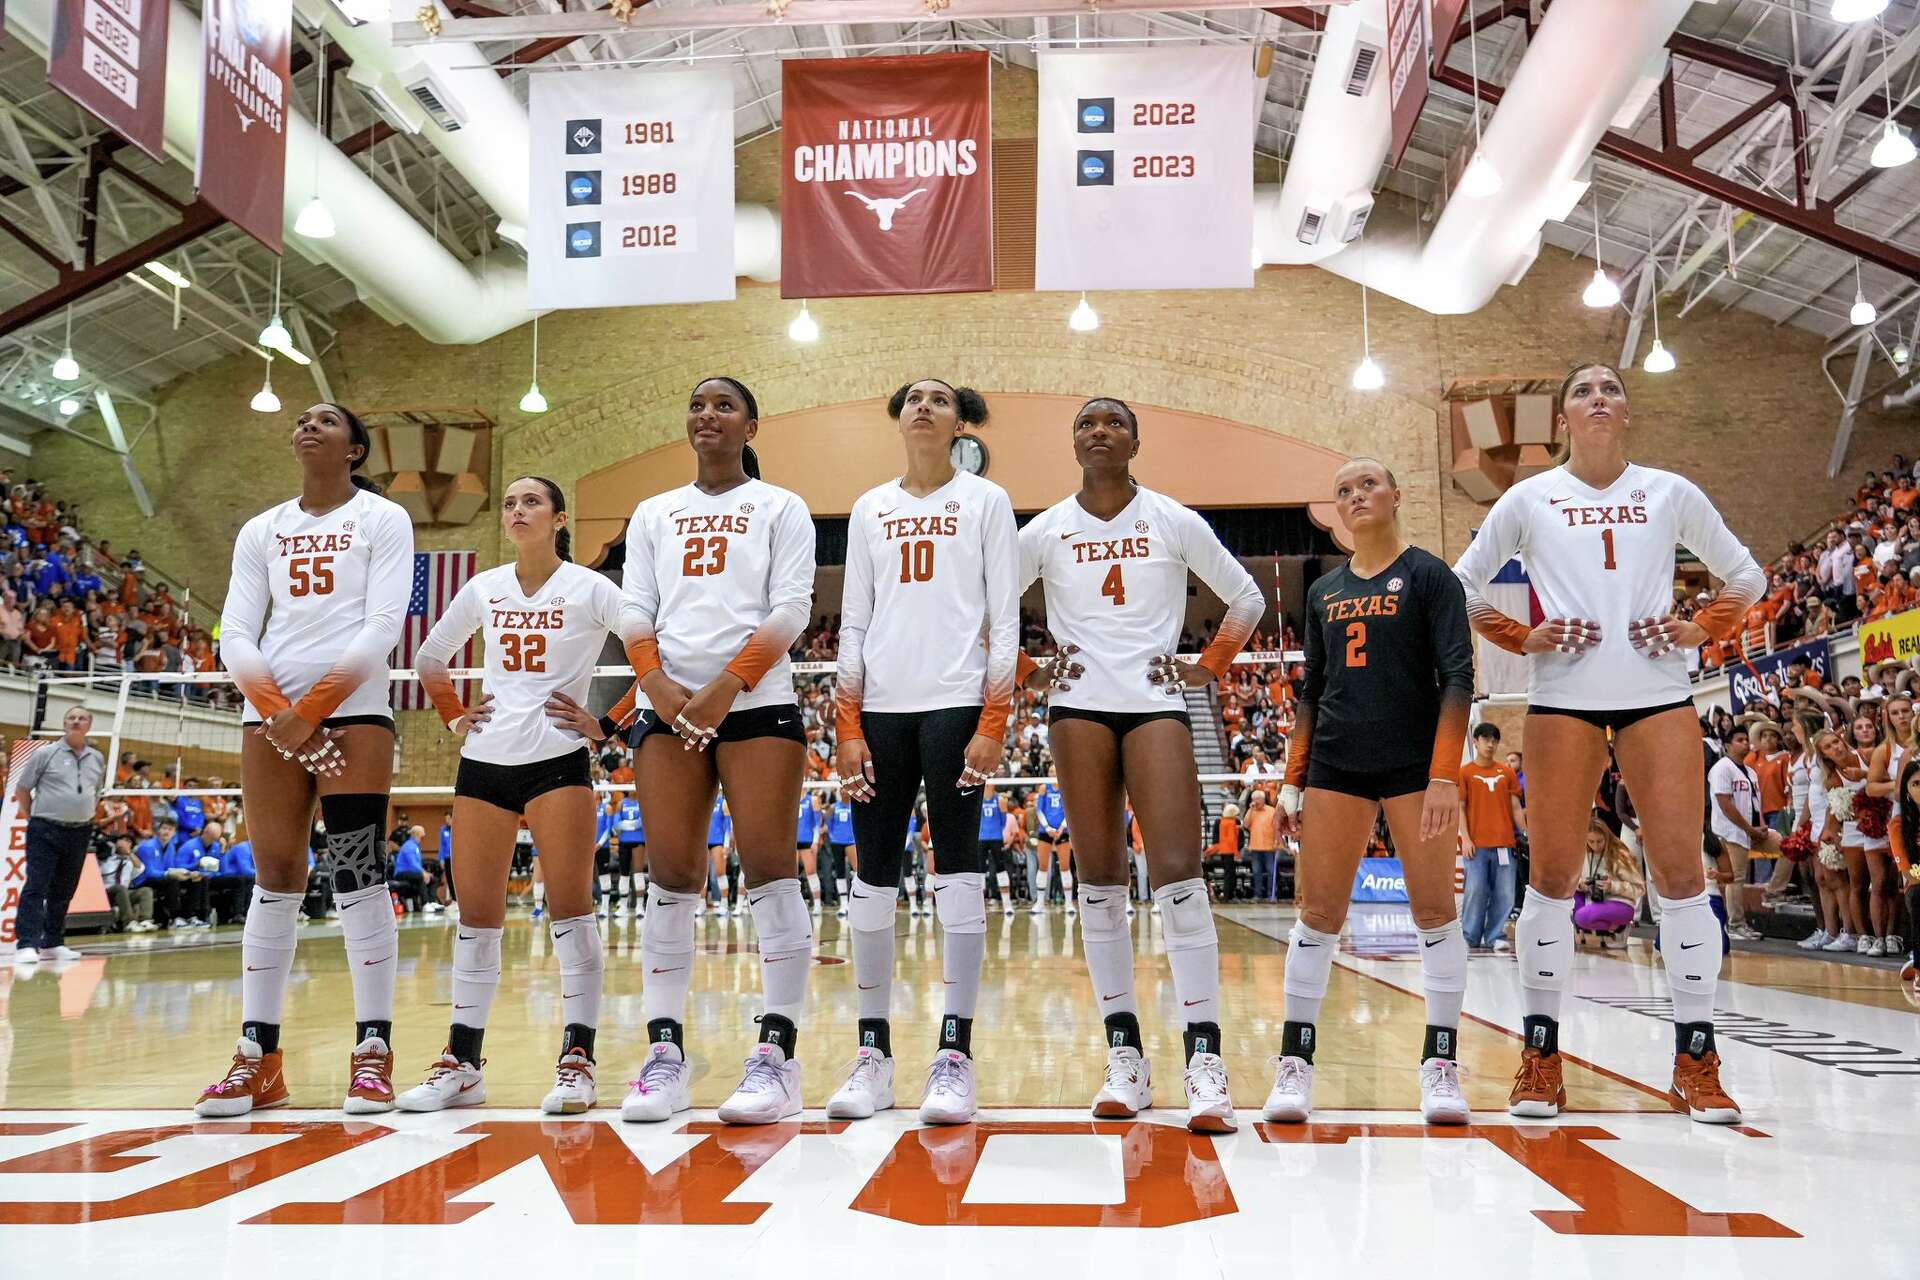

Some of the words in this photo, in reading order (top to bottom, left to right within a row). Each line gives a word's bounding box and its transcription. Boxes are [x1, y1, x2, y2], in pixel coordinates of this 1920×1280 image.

[95, 13, 129, 55] 2022
[93, 53, 127, 94] 2023
[250, 54, 283, 110] FOUR
[209, 53, 282, 134] APPEARANCES
[1133, 103, 1196, 125] 2022
[625, 121, 674, 144] 1981
[839, 117, 932, 139] NATIONAL
[794, 139, 978, 183] CHAMPIONS
[1133, 155, 1195, 178] 2023
[622, 172, 676, 196] 1988
[622, 225, 677, 248] 2012
[675, 515, 750, 536] TEXAS
[883, 516, 958, 540] TEXAS
[1562, 505, 1648, 527] TEXAS
[278, 534, 353, 557] TEXAS
[683, 536, 728, 577] 23
[1072, 537, 1150, 563] TEXAS
[1601, 528, 1617, 570] 1
[900, 540, 934, 583] 10
[289, 556, 334, 597] 55
[1101, 564, 1125, 606] 4
[491, 609, 564, 629] TEXAS
[1327, 594, 1400, 623] TEXAS
[500, 633, 546, 673] 32
[1346, 622, 1367, 668] 2
[1361, 873, 1407, 890] Ame
